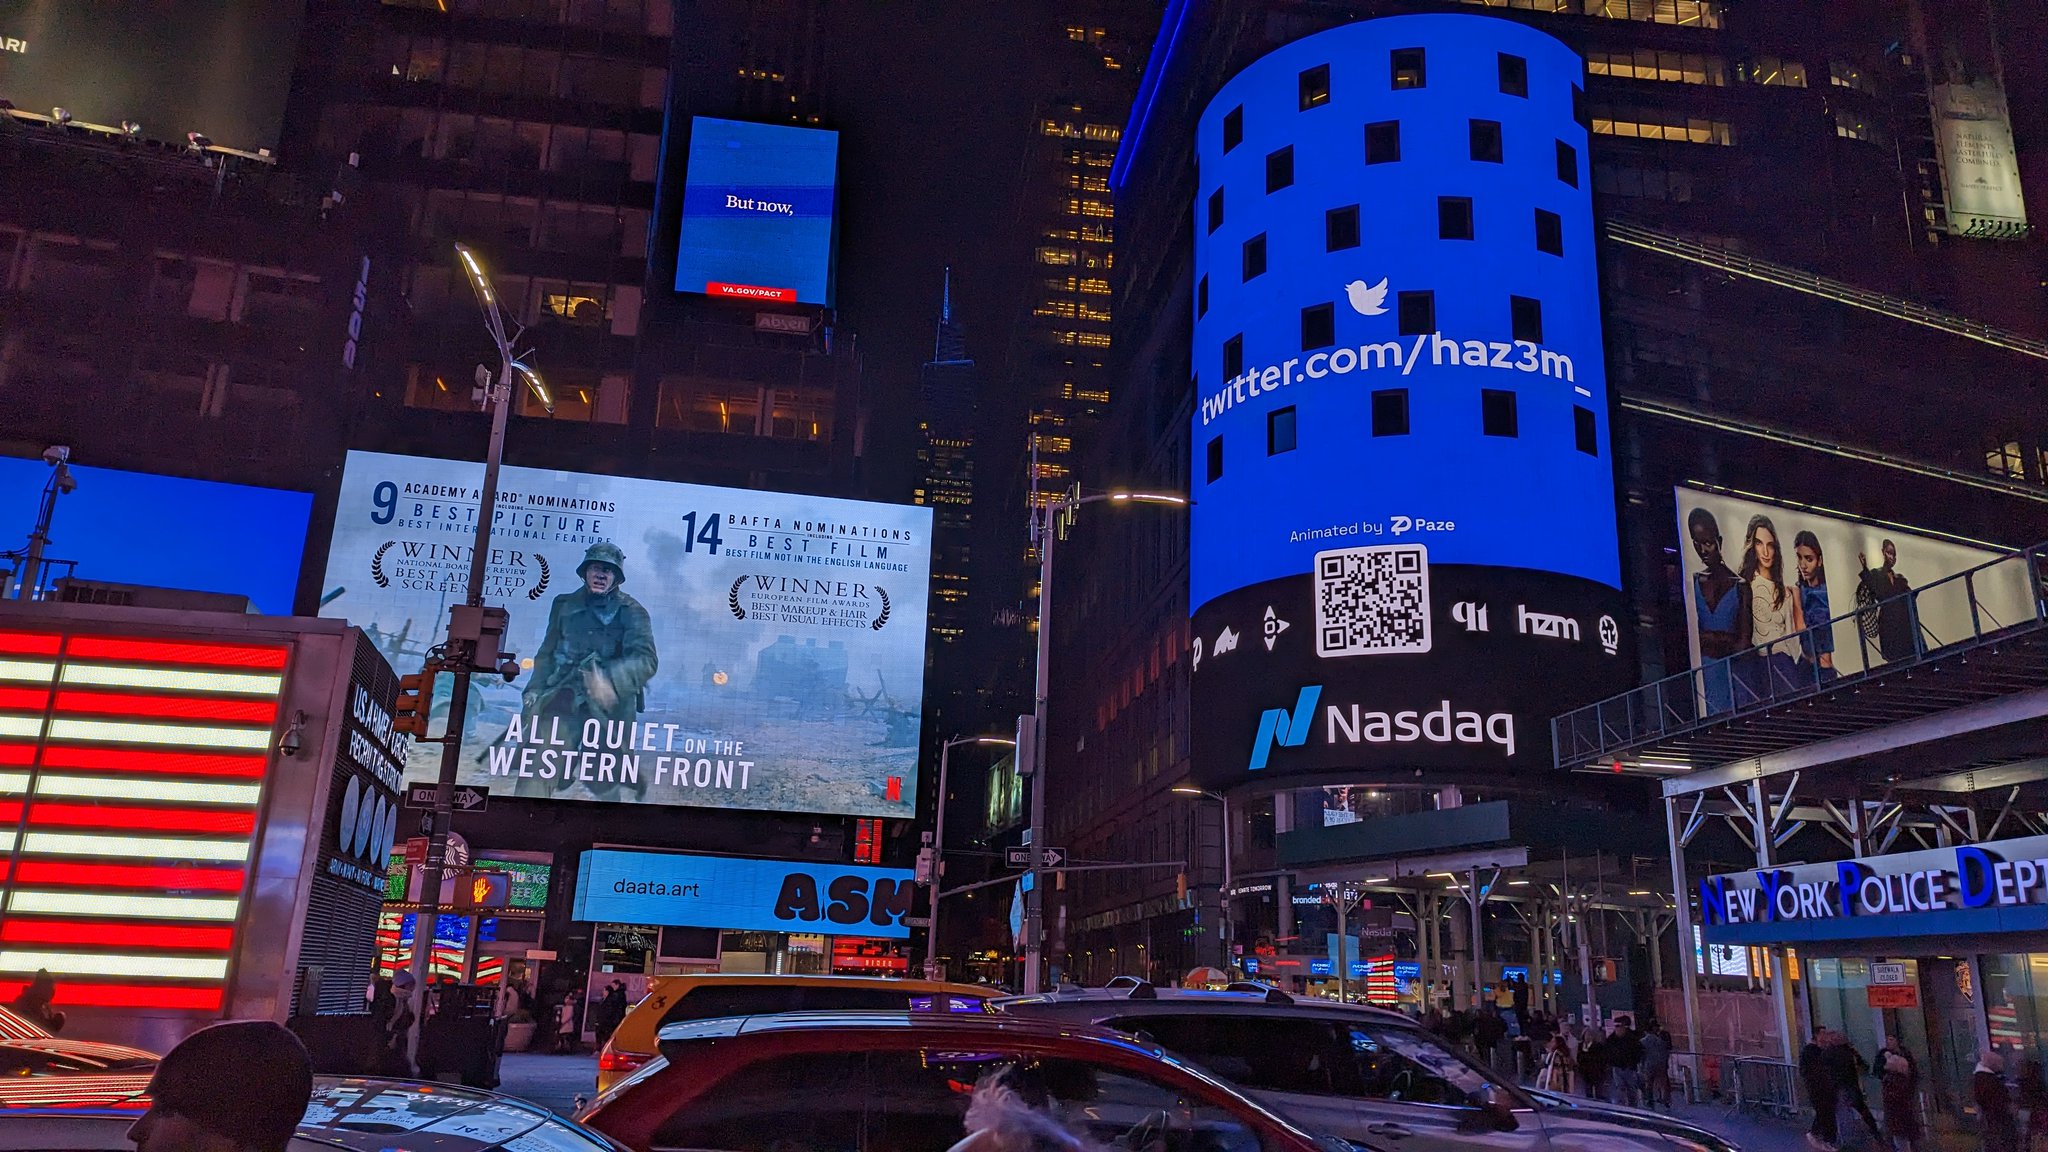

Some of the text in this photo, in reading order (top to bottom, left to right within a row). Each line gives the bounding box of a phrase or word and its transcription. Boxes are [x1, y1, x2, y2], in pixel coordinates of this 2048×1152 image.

[725, 194, 794, 216] But now,
[722, 286, 782, 298] VA.GOV/PACT
[371, 481, 398, 525] 9
[404, 483, 615, 513] ACADEMY AARD NOMINATIONS
[398, 519, 431, 530] BEST
[440, 522, 547, 540] INTERATIONAL
[413, 503, 601, 534] BEST PICTURE
[728, 514, 911, 541] BAFTA NOMINATIONS
[1289, 518, 1456, 543] Animated by Paze
[682, 510, 723, 555] 14
[749, 534, 888, 559] BEST FILM
[397, 558, 443, 569] NATIONAL
[445, 562, 470, 571] BOAR
[493, 567, 528, 576] REVIEW
[726, 548, 908, 572] BEST FILM NOT IN THE ENGLISH LANGUAGE
[395, 567, 438, 580] BEST
[402, 578, 516, 598] SCREENLAY
[754, 574, 869, 599] WINNER
[751, 592, 870, 608] EUROPEAN FILM AWARDS
[751, 602, 867, 619] BEST MAKEUP & HAIR
[751, 611, 867, 628] BEST VISUAL EFFECTS
[1517, 604, 1580, 641] hzm
[504, 714, 744, 757] ALL QUIET ON THE
[1327, 700, 1516, 757] Nasdaq
[488, 745, 755, 791] WESTERN FRONT
[418, 790, 435, 801] ON
[613, 878, 700, 898] daata.art
[1700, 846, 2048, 925] NEW YORK POLICE DEPT
